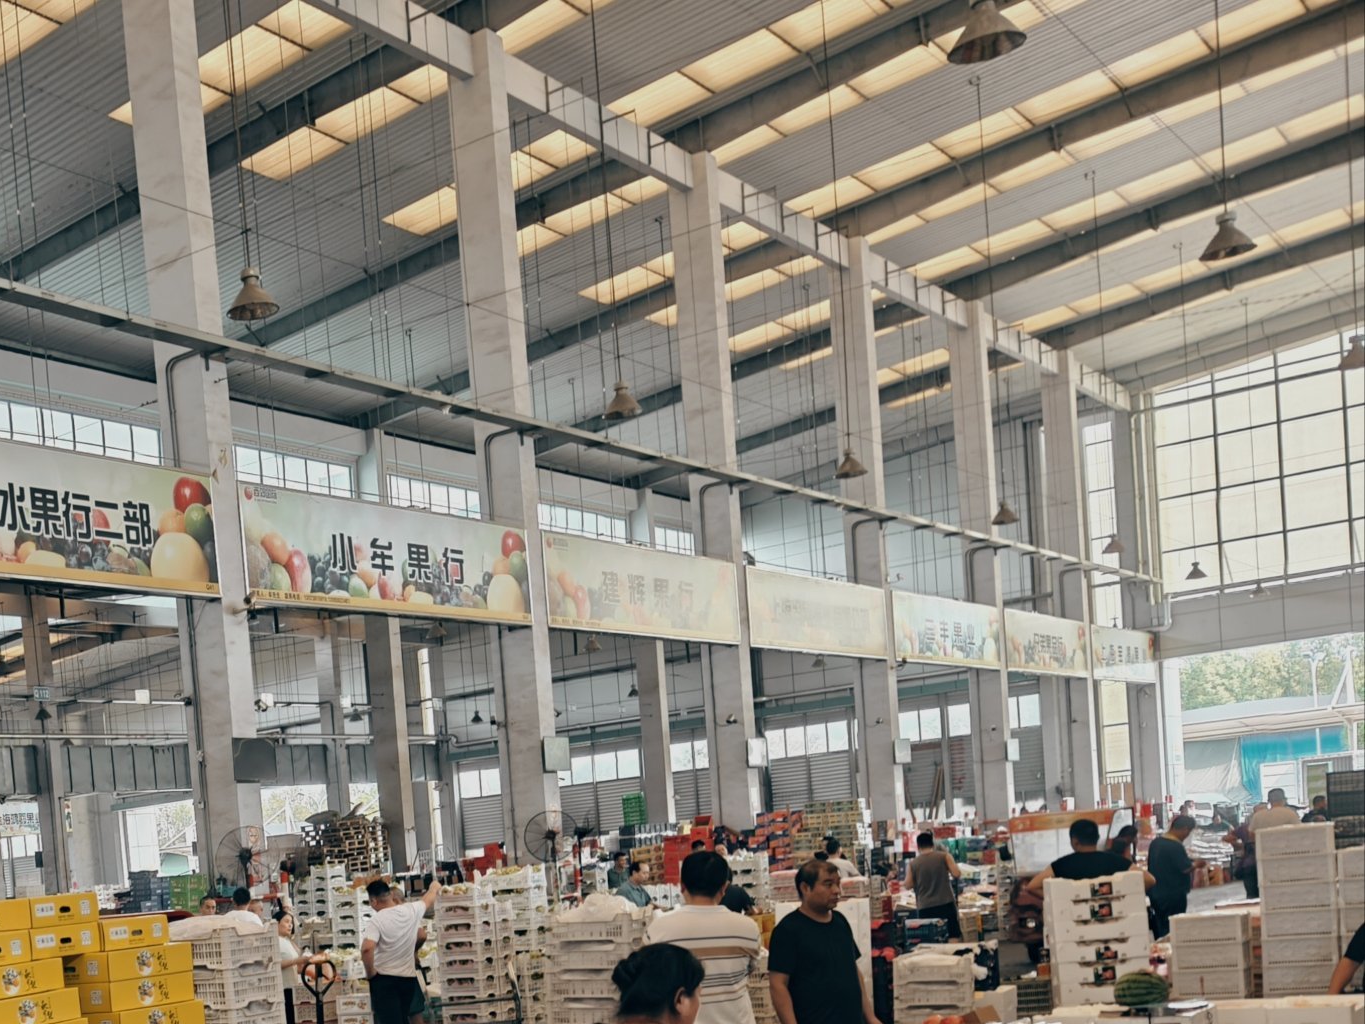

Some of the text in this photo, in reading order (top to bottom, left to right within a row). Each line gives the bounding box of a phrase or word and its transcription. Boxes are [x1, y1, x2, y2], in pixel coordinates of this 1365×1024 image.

[331, 533, 465, 584] 小牟果行
[601, 571, 694, 615] 建辉果行
